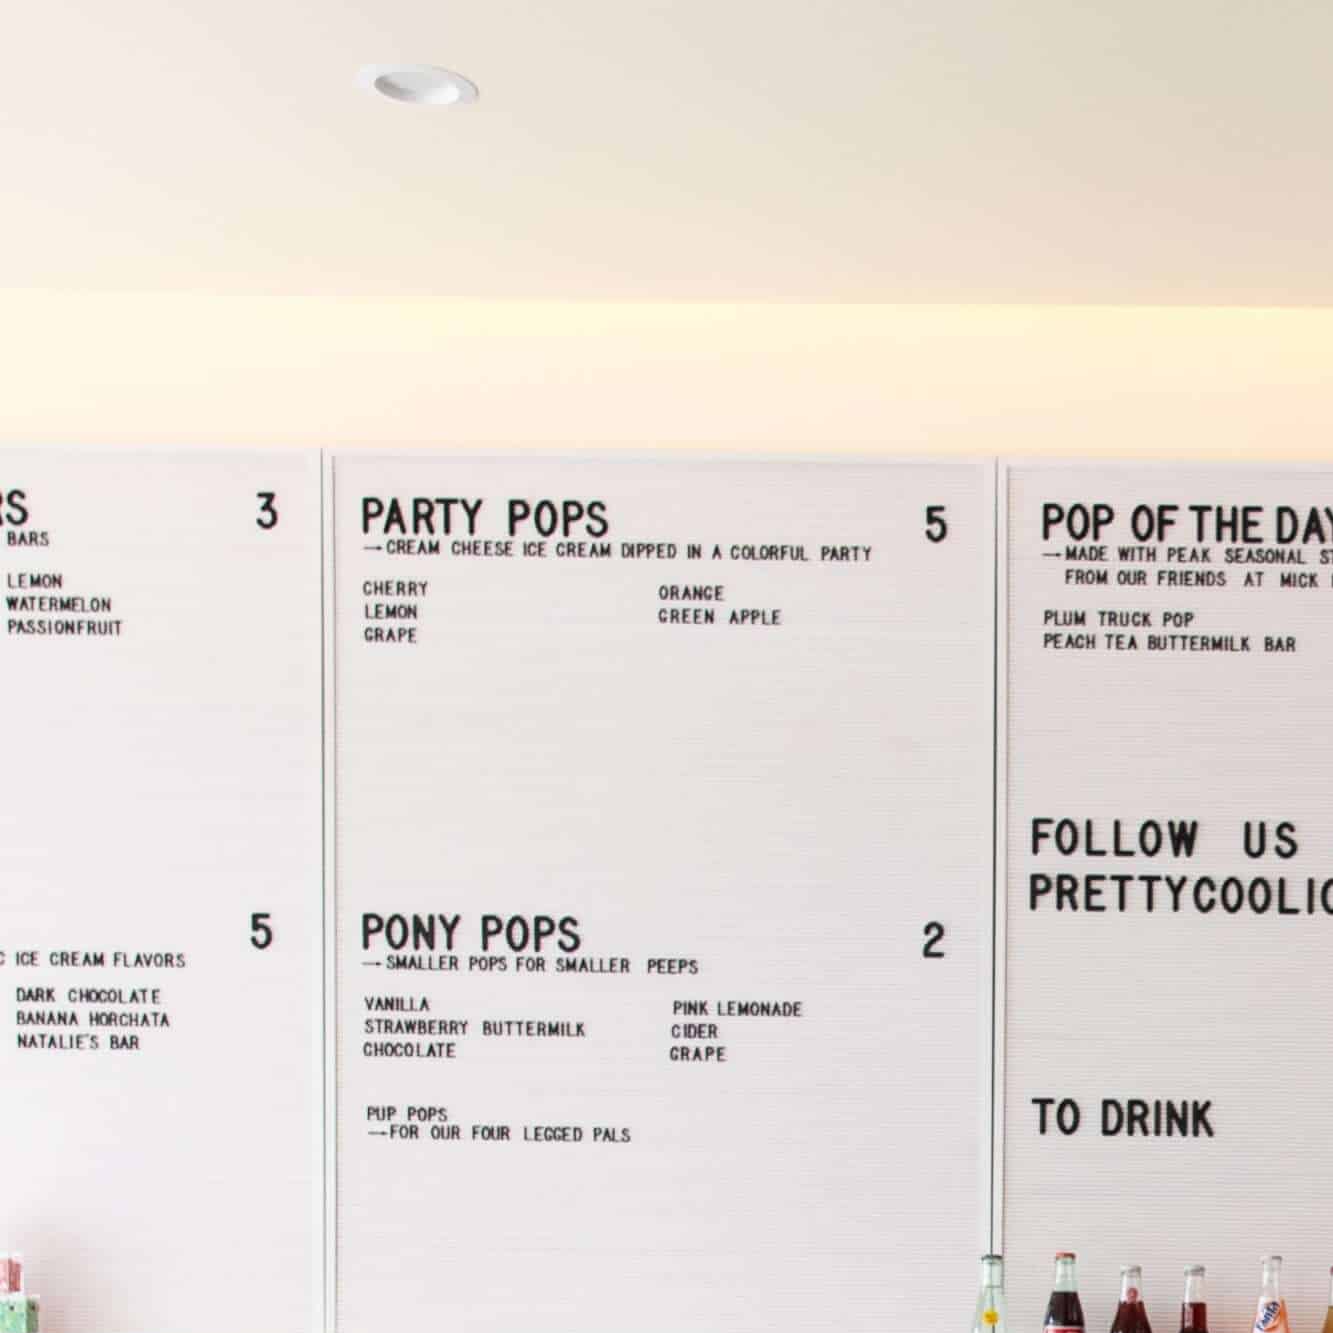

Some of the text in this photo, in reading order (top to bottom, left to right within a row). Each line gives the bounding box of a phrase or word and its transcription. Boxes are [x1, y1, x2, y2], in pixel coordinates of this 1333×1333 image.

[0, 489, 29, 527] S
[256, 491, 279, 530] 3
[362, 496, 609, 539] PARTY POPS
[925, 505, 948, 544] 5
[1042, 502, 1116, 543] POP
[1130, 502, 1178, 544] OF
[1188, 504, 1264, 545] THE
[7, 530, 50, 546] BARS
[386, 538, 872, 562] CREAM CHEESE ICE CREAM DIPPED IN A COLORFUL PARTY
[1065, 545, 1107, 562] MADE
[1117, 545, 1157, 562] WITH
[1167, 546, 1211, 563] PEAK
[1224, 547, 1306, 565] SEASONAL
[7, 573, 63, 589] LEMON
[1065, 568, 1108, 585] FROM
[1116, 569, 1148, 586] OUR
[1157, 569, 1227, 587] FRIENDS
[1243, 571, 1265, 587] AT
[1279, 572, 1319, 589] MICK
[362, 580, 428, 597] CHERRY
[658, 584, 724, 601] ORANGE
[5, 595, 112, 613] WATERMELON
[364, 603, 418, 620] LEMON
[658, 607, 780, 626] GREEN APPLE
[1043, 609, 1195, 628] PLUM TRUCK POP
[7, 618, 121, 636] PASSIONFRUIT
[363, 626, 417, 644] GRAPE
[1043, 632, 1296, 653] PEACH TEA BUTTERMILK BAR
[1031, 817, 1199, 858] FOLLOW
[1243, 820, 1299, 860] US
[250, 912, 273, 950] 5
[362, 912, 581, 954] PONY POPS
[922, 921, 945, 959] 2
[15, 951, 38, 966] ICE
[49, 951, 105, 967] CREAM
[113, 951, 186, 968] FLAVORS
[386, 954, 699, 975] SMALLER POPS FOR SMALLER PEEPS
[16, 987, 160, 1005] DARK CHOCOLATE
[364, 996, 430, 1012] VANILLA
[673, 1000, 801, 1017] PINK LEMONADE
[16, 1010, 170, 1027] BANANA HORCHATA
[364, 1018, 585, 1037] STRAWBERRY BUTTERMILK
[671, 1023, 718, 1040] CIDER
[17, 1033, 139, 1050] NATALIE'S BAR
[362, 1041, 456, 1059] CHOCOLATE
[669, 1045, 725, 1062] GRAPE
[367, 1105, 448, 1122] PUP POPS
[1031, 1097, 1215, 1138] TO DRINK
[389, 1124, 631, 1143] FOR OUR FOUR LEGGED PALS
